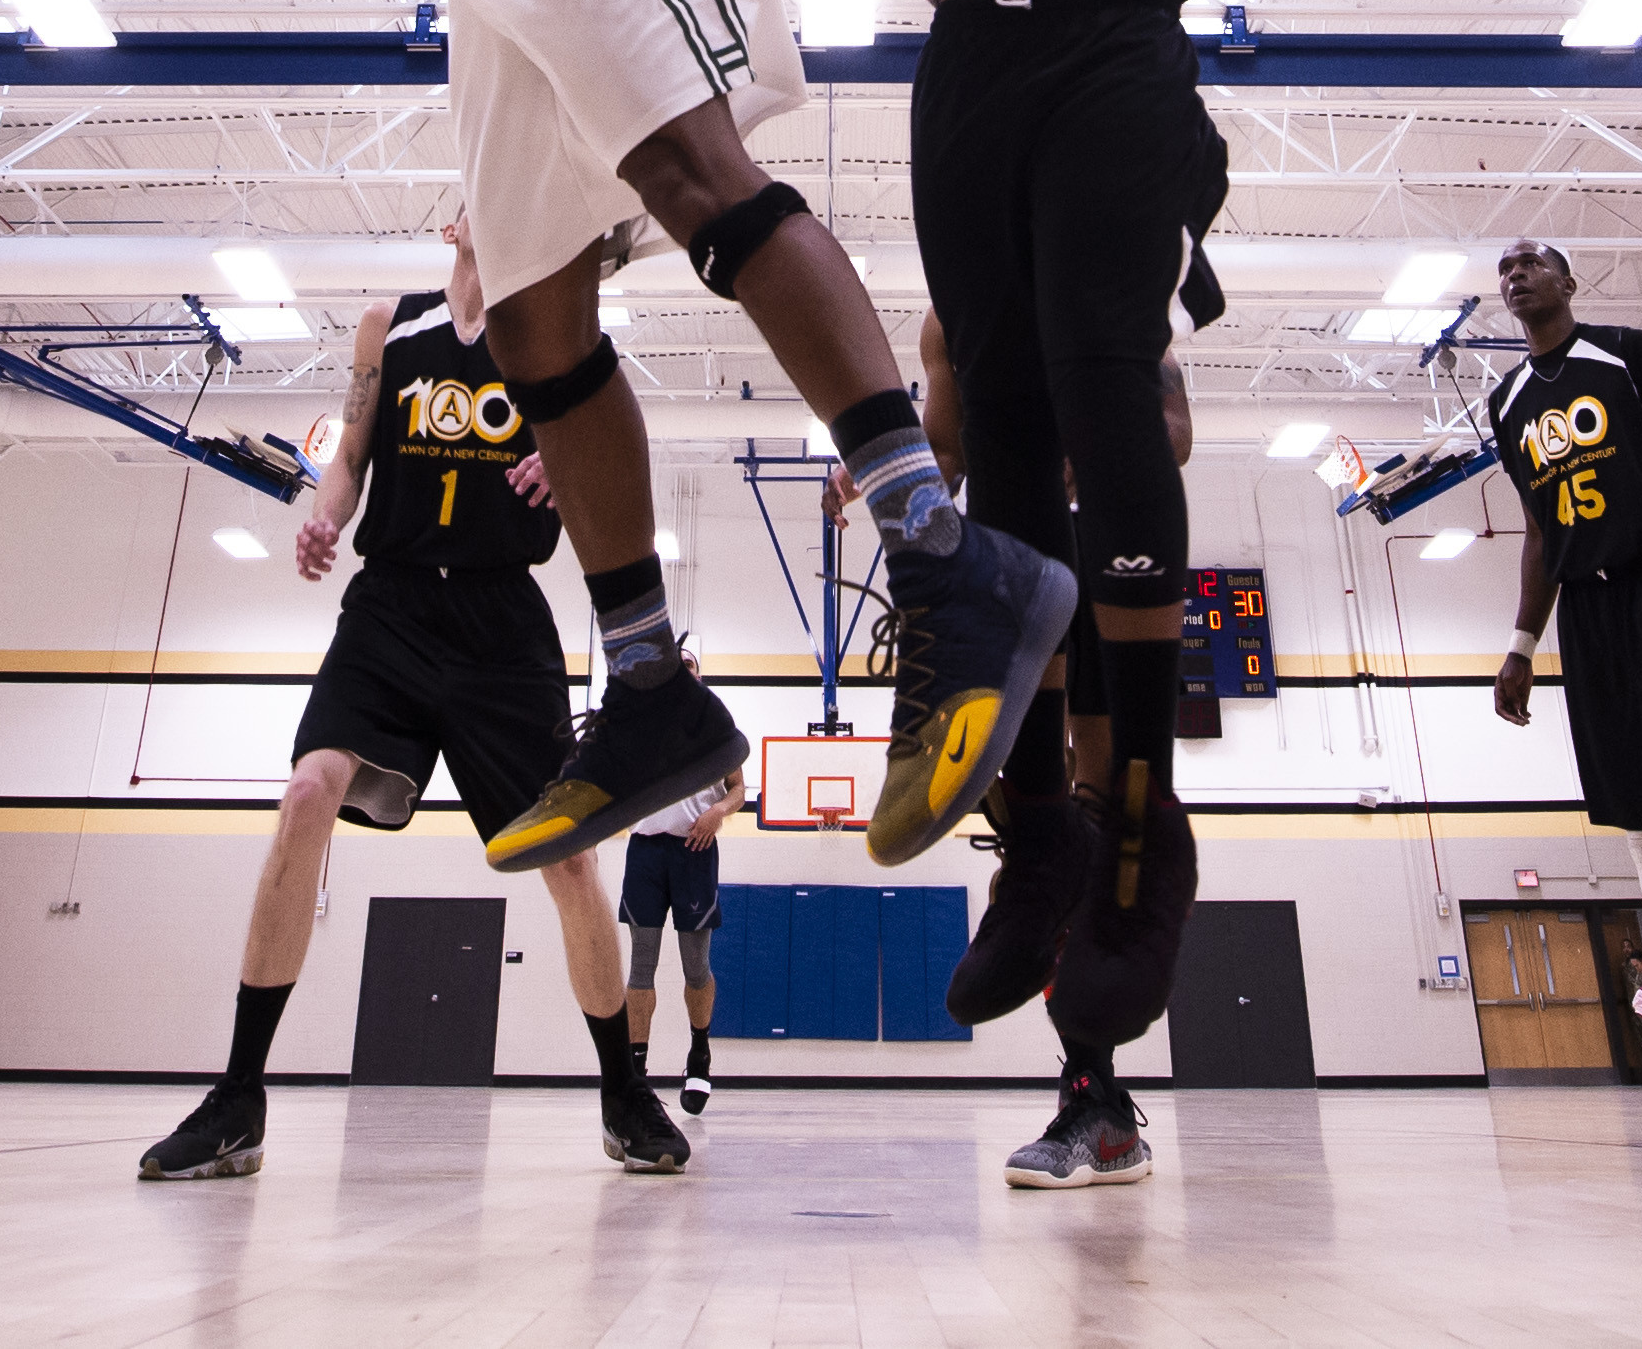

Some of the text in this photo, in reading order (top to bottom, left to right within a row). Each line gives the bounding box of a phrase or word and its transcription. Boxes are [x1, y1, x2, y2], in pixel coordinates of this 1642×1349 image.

[399, 444, 517, 463] AWN OF A NEW CENTURY
[1579, 445, 1617, 464] CENTURY
[439, 469, 458, 526] 1
[1557, 469, 1606, 527] 45
[1227, 574, 1260, 587] Guests
[1233, 591, 1264, 617] 30
[1209, 610, 1222, 630] 0
[1247, 654, 1260, 675] 0
